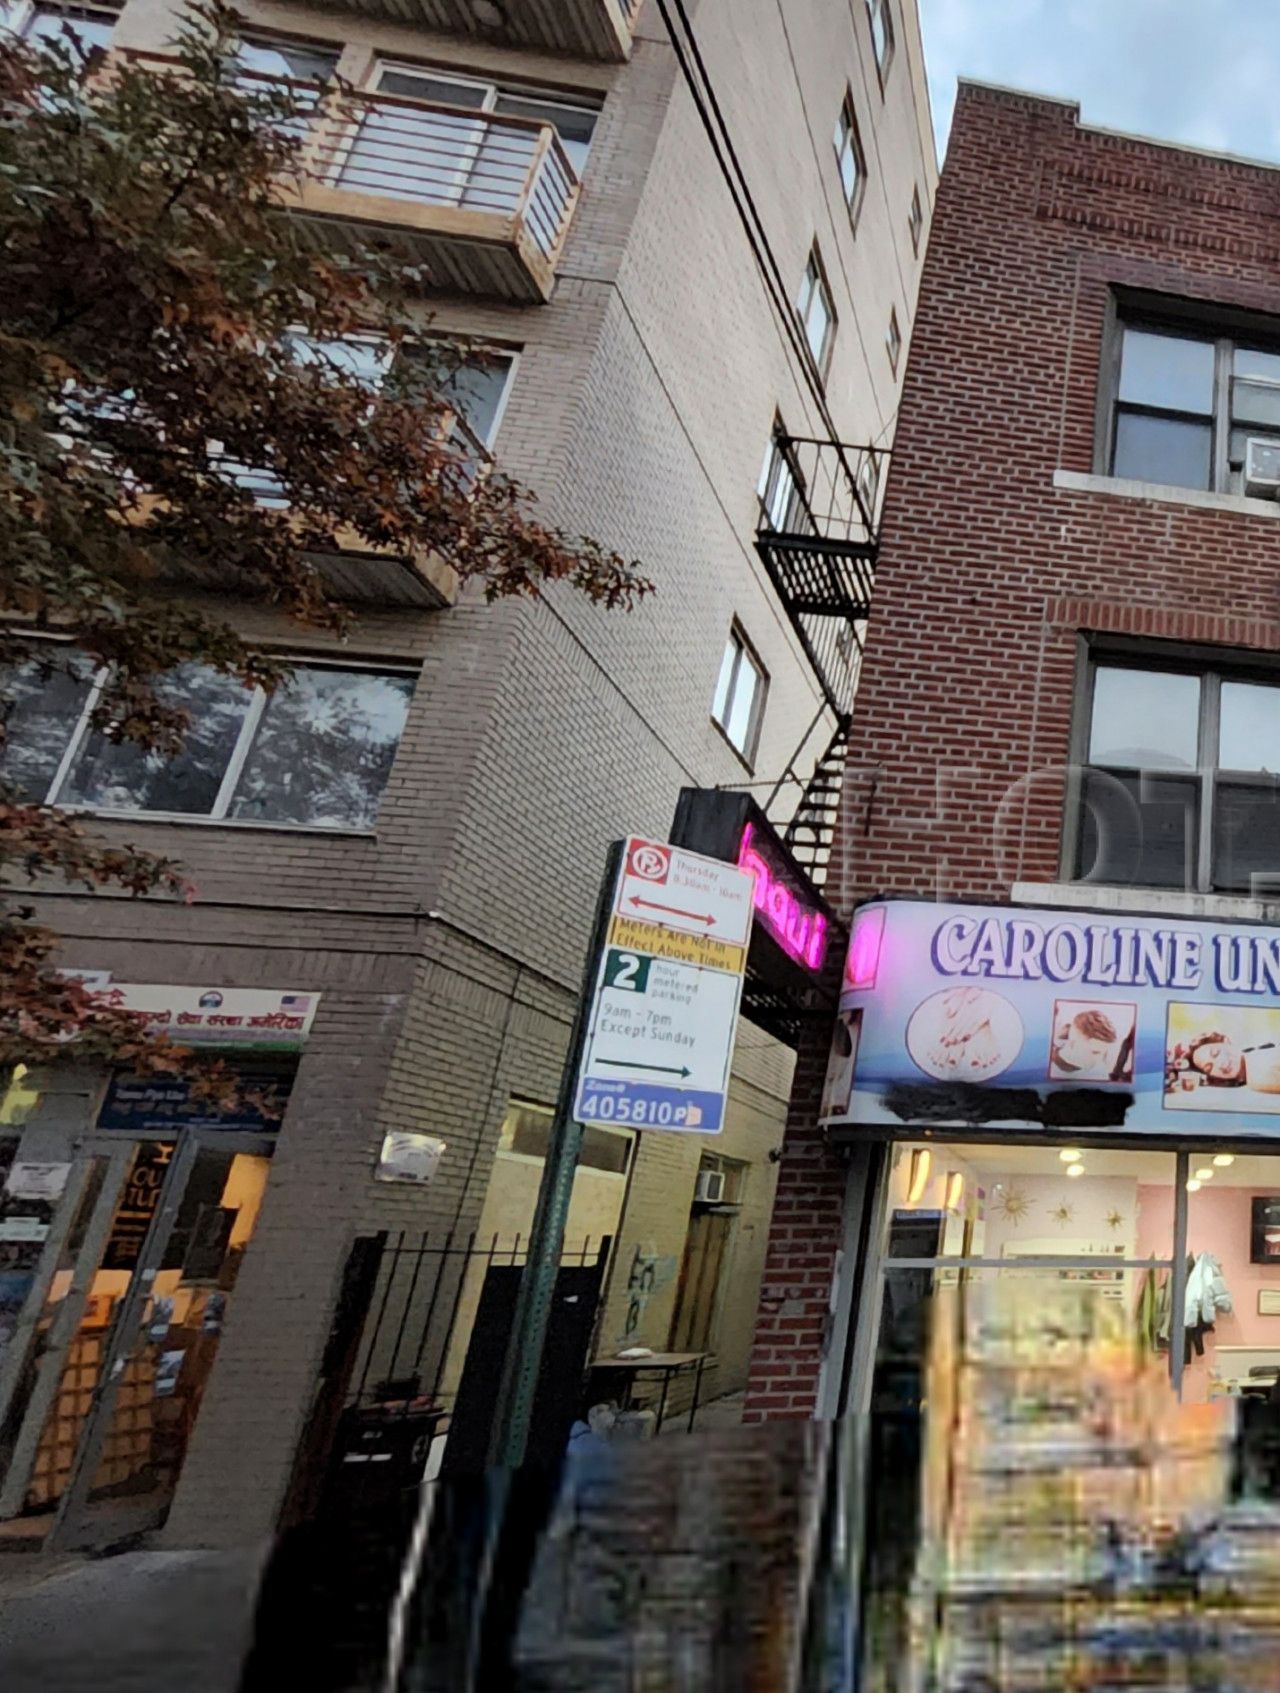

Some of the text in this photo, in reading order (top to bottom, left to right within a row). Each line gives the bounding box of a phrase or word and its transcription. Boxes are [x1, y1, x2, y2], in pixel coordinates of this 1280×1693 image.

[617, 932, 654, 952] Effect
[657, 943, 695, 961] Above
[931, 914, 1204, 991] CAROLINE
[613, 954, 640, 990] 2
[656, 964, 680, 977] hour
[604, 1003, 631, 1019] 9am
[646, 1008, 672, 1026] 7pm
[600, 1019, 696, 1048] Except Sunday
[582, 1094, 672, 1125] 405810
